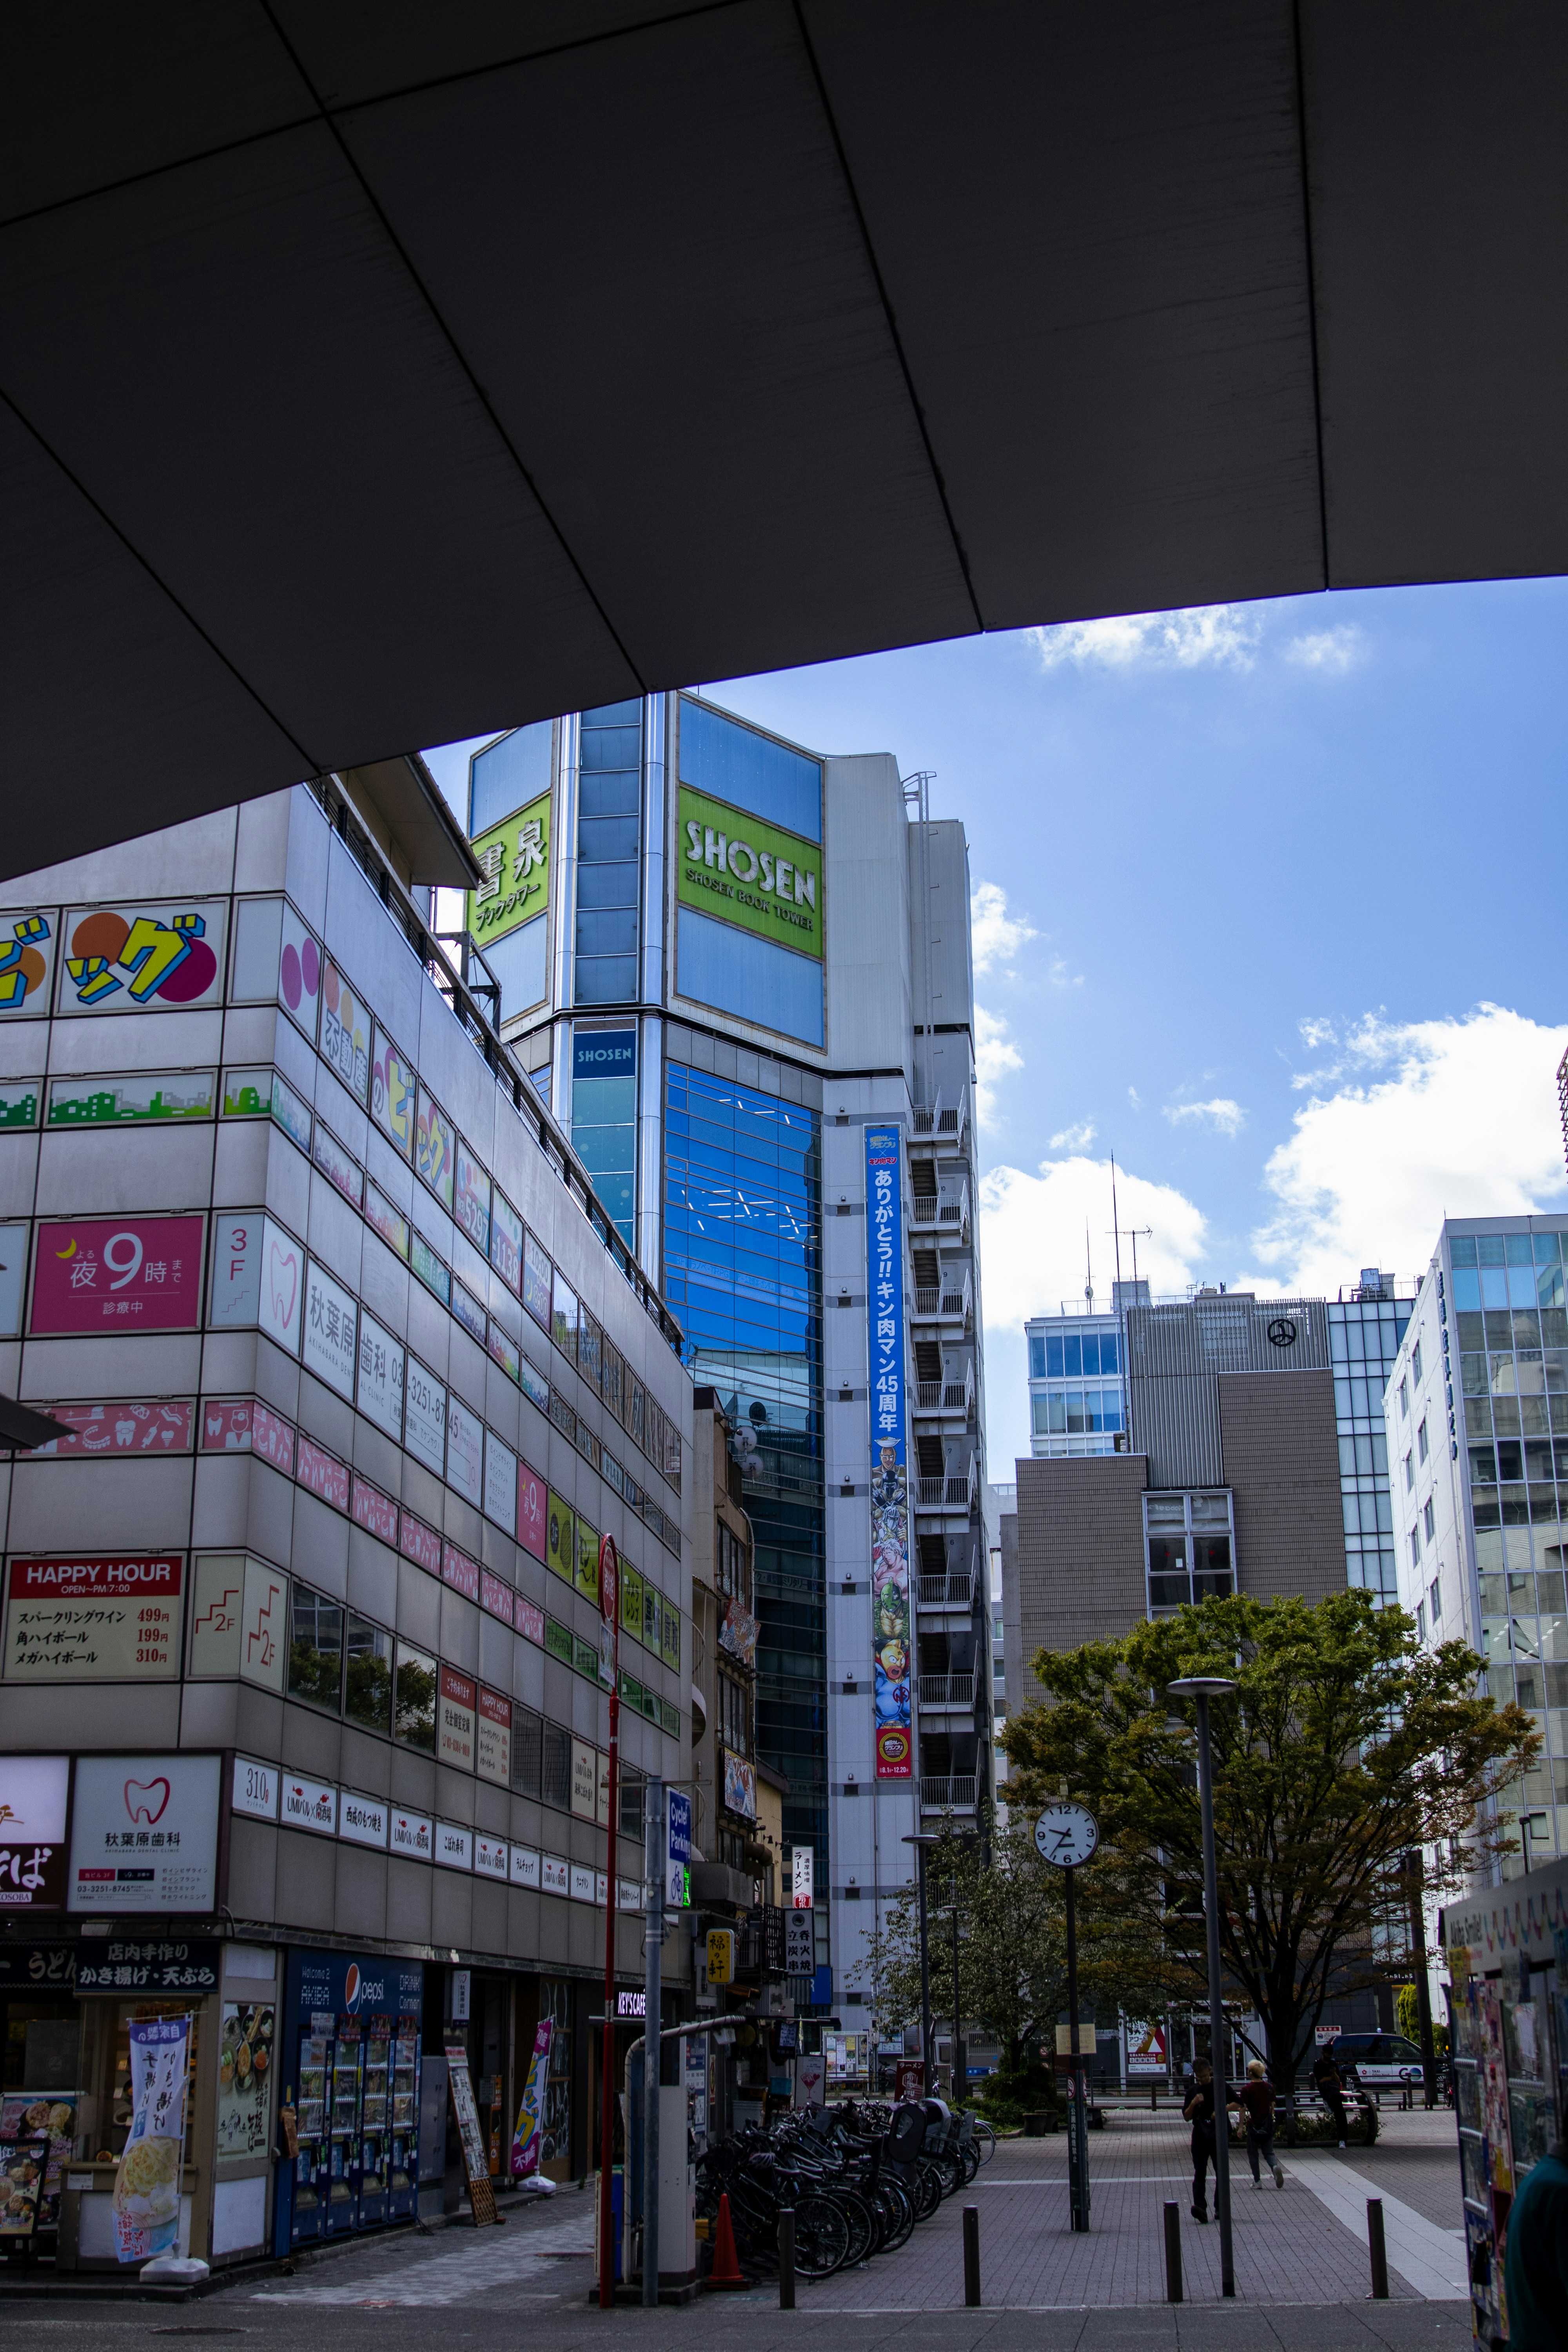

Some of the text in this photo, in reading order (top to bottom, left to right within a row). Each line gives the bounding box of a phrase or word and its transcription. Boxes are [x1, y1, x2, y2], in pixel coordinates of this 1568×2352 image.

[476, 817, 547, 907] 書泉
[686, 820, 816, 912] SHOSEN
[475, 883, 540, 931] ブックタワー
[686, 868, 814, 931] SHOSEN BOOK TOWER
[578, 1047, 632, 1063] SHOSEN
[869, 1157, 897, 1165] キン肉マン
[76, 1250, 94, 1259] よる
[532, 1245, 548, 1284] 10:00
[103, 1301, 143, 1315] 診療中
[534, 1285, 548, 1321] 8:00
[310, 1285, 386, 1389] 秋葉原歯科
[309, 1336, 339, 1367] AKIHABARA
[368, 1386, 385, 1407] CLINIC
[392, 1357, 458, 1438] 03-3251-8745
[551, 1524, 558, 1544] 3F
[27, 1563, 171, 1584] HAPPY HOUR
[604, 1564, 614, 1601] 消火栓
[18, 1608, 169, 1625] スパークリングワイン 499円
[626, 1596, 640, 1626] レンズ
[214, 1613, 235, 1632] 2F
[16, 1628, 168, 1646] 角ハイボール 199円
[15, 1648, 167, 1665] メガハイボール 310円
[261, 1630, 276, 1667] 2F
[446, 1677, 470, 1700] ご予約承ります
[482, 1692, 496, 1710] HAPPY
[497, 1700, 508, 1717] HOUR
[246, 1768, 267, 1800] 310
[287, 1796, 332, 1823] UMIバル×肉酒場
[346, 1806, 381, 1832] 西成のもつ焼き
[671, 1802, 687, 1827] Cycle
[1057, 1805, 1071, 1814] 12
[105, 1831, 181, 1847] 秋葉原歯科
[1037, 1831, 1045, 1840] 9
[1087, 1828, 1094, 1837] 3
[444, 1836, 464, 1856] こぼれ寿司
[671, 1829, 691, 1860] Parking
[0, 1847, 53, 1890] ば
[516, 1857, 534, 1874] ラムチョップ
[1063, 1854, 1072, 1864] 6
[794, 1851, 802, 1889] ラーメン
[576, 1875, 589, 1890] ウニプリン
[787, 1929, 811, 1942] 立呑
[108, 1944, 189, 1961] 店内手作り
[788, 1945, 810, 1956] 炭火
[302, 1965, 330, 1980] Welcome 2
[788, 1960, 811, 1971] 串焼
[79, 1966, 216, 1986] かき揚げ・天ぷら
[399, 1975, 421, 1991] DRINK
[301, 1985, 330, 2006] AKIBA
[361, 1978, 384, 2005] pepsi
[618, 1988, 646, 2015] KEY'S CAFÉ
[399, 1995, 420, 2010] Corner
